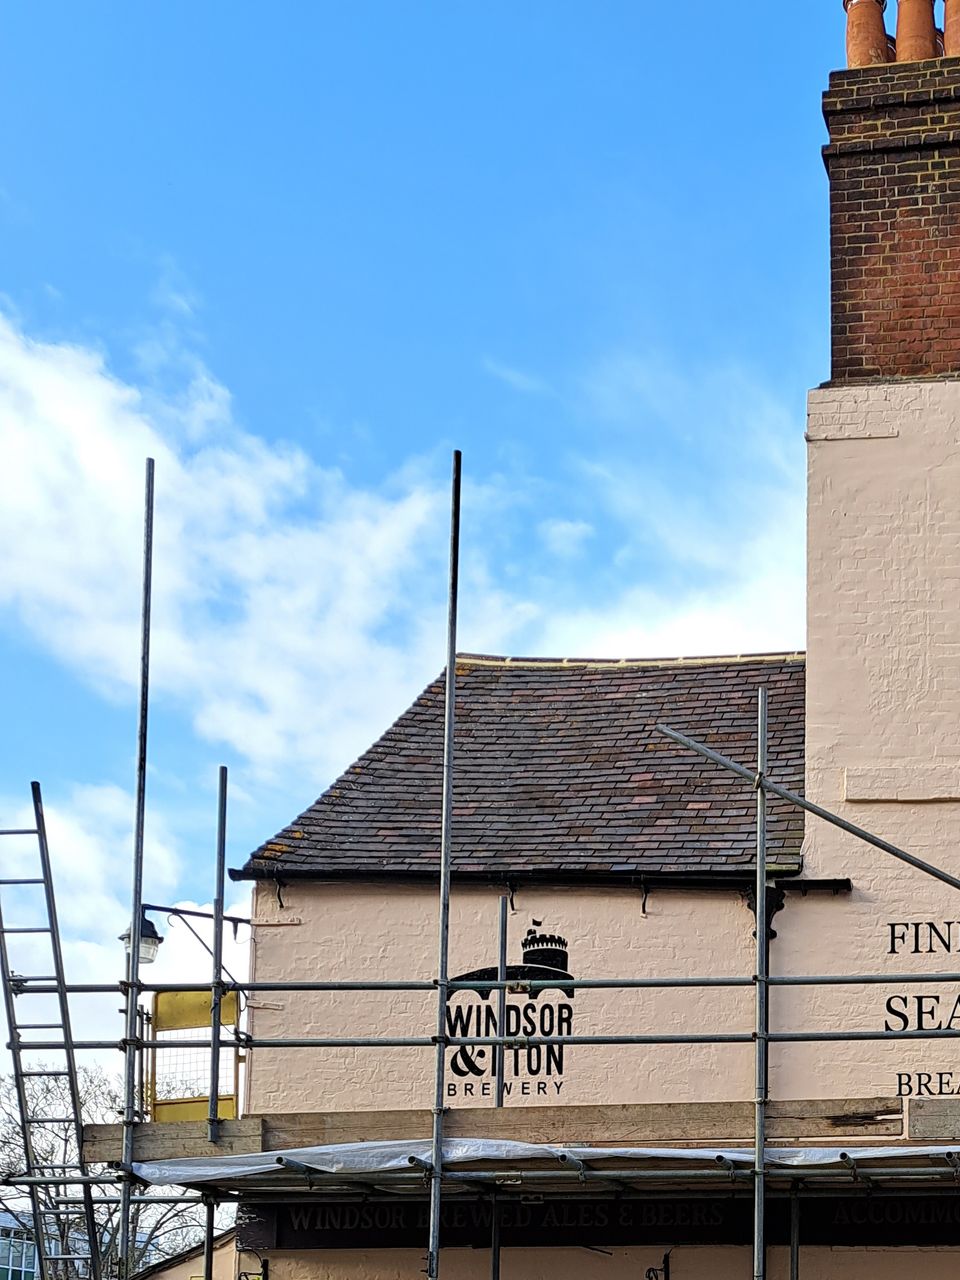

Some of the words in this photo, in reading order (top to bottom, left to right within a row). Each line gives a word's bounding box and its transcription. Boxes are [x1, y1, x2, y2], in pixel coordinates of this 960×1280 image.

[446, 1003, 573, 1038] WINDSOR
[450, 1044, 487, 1077] &
[491, 1043, 564, 1077] TON
[447, 1081, 563, 1096] BREWERY
[289, 1204, 407, 1231] WINDSOR
[542, 1203, 610, 1228] ALES
[640, 1202, 724, 1227] BEERS
